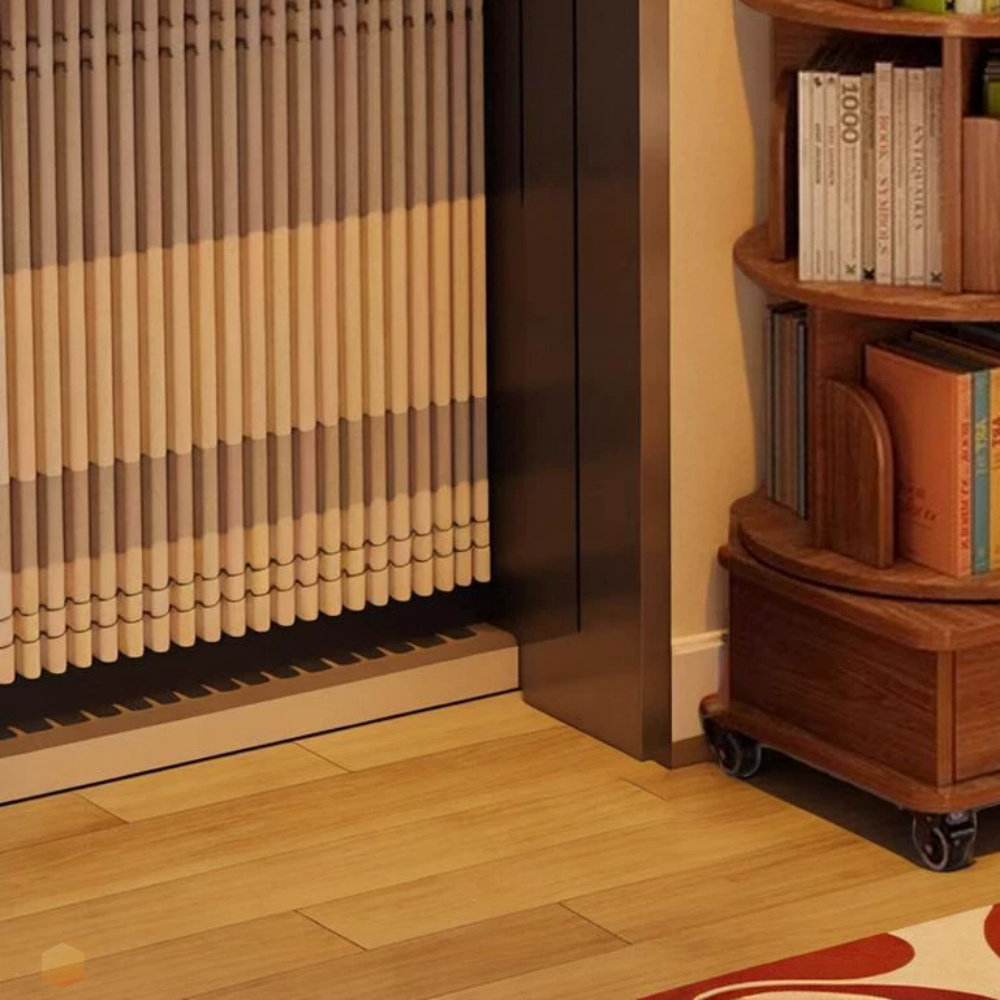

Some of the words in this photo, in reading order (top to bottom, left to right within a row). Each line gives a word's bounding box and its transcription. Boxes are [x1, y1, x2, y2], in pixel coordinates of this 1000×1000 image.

[841, 83, 860, 144] 1000
[878, 114, 889, 160] BOOK
[911, 125, 924, 231] ANTIQUAIRES
[878, 177, 890, 256] SYMBOLS
